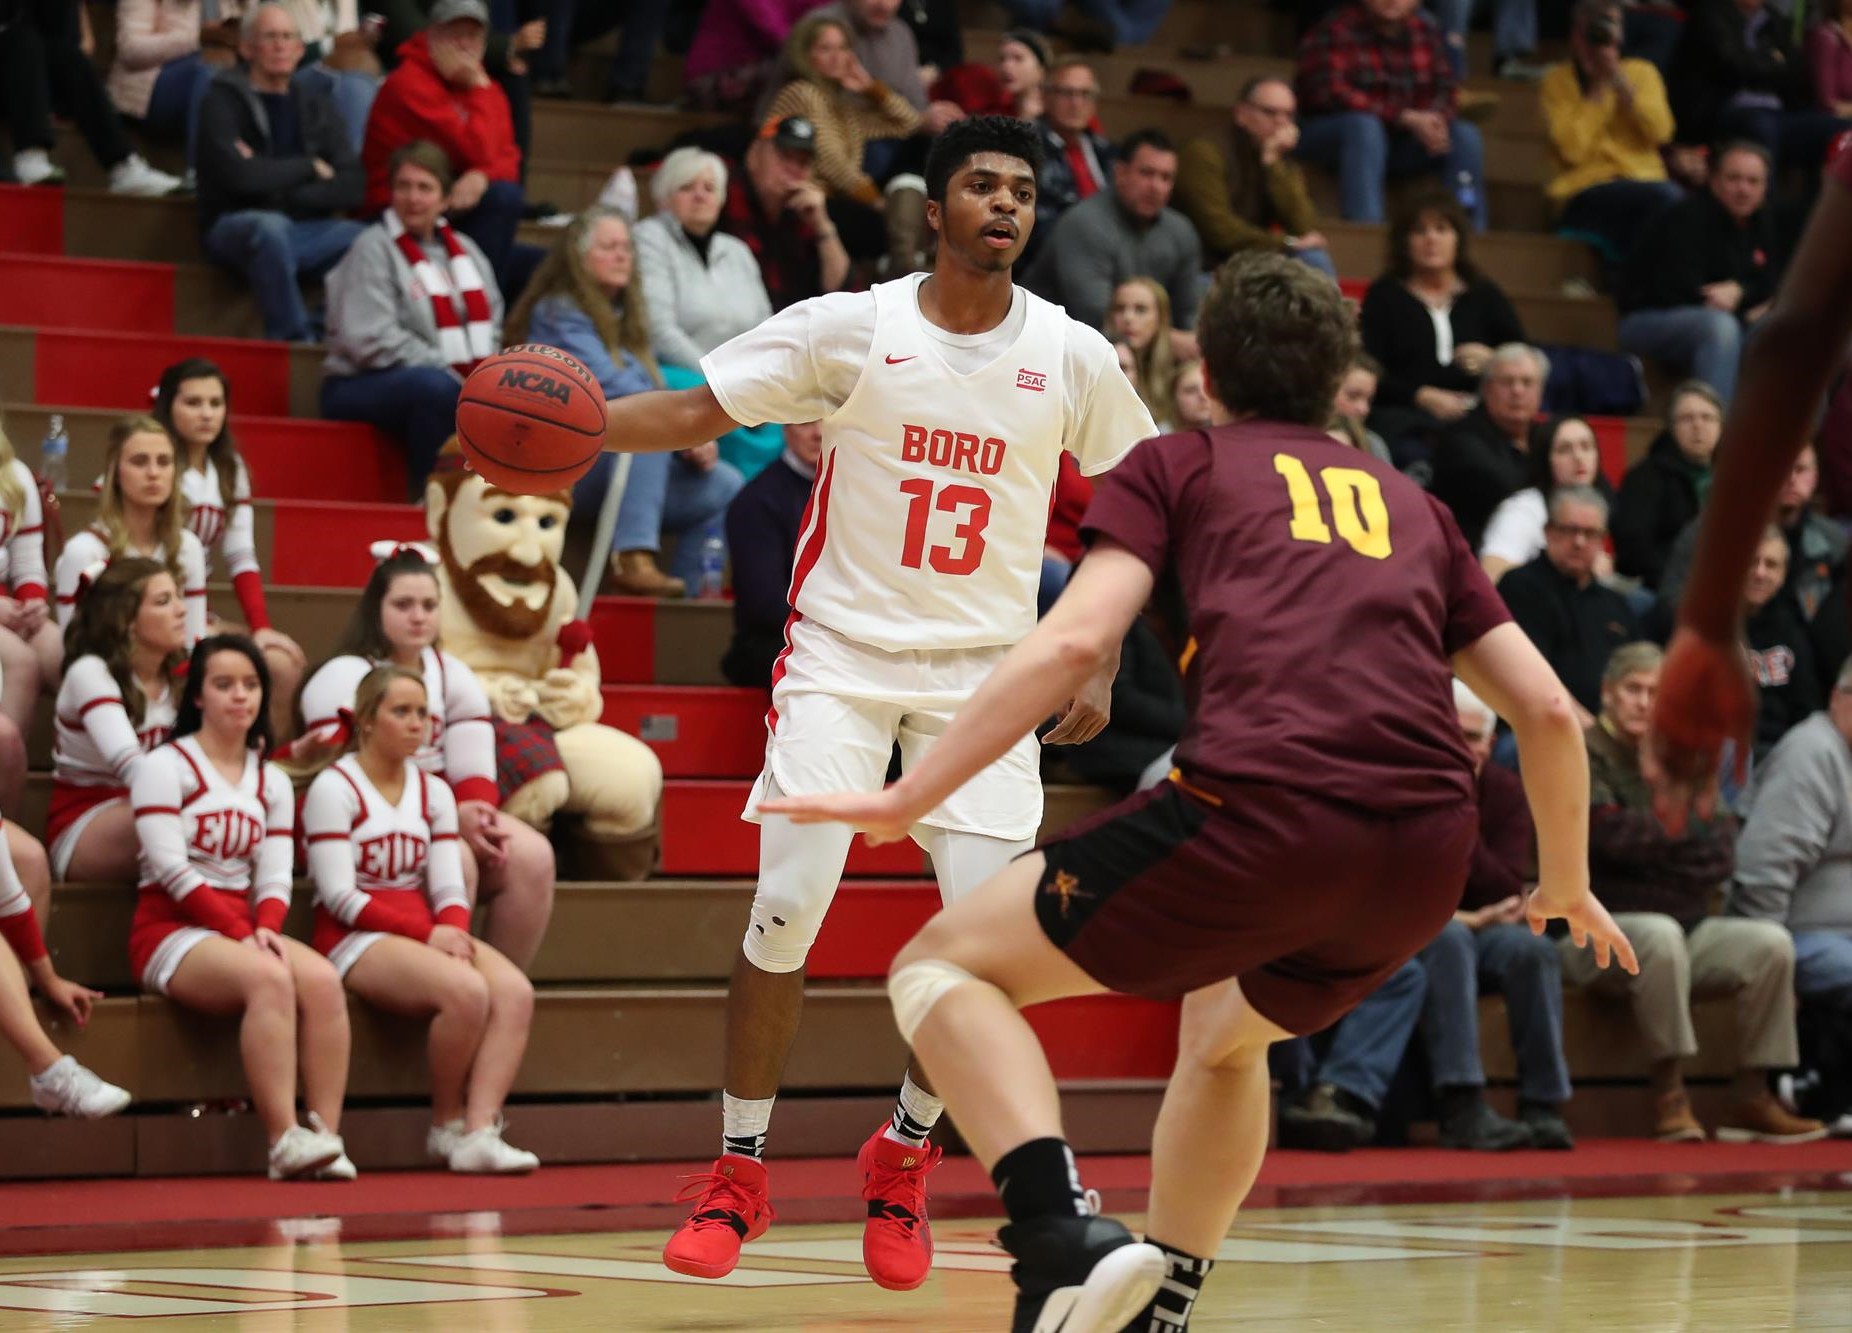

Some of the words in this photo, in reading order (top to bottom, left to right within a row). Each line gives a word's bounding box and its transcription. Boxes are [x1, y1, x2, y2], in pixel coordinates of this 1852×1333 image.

[498, 368, 571, 405] NCAA
[1017, 373, 1047, 388] PSAC
[902, 424, 1007, 475] BORO
[900, 478, 993, 576] 13
[1273, 453, 1393, 560] 10
[192, 809, 263, 860] EUP
[357, 832, 427, 880] EUP
